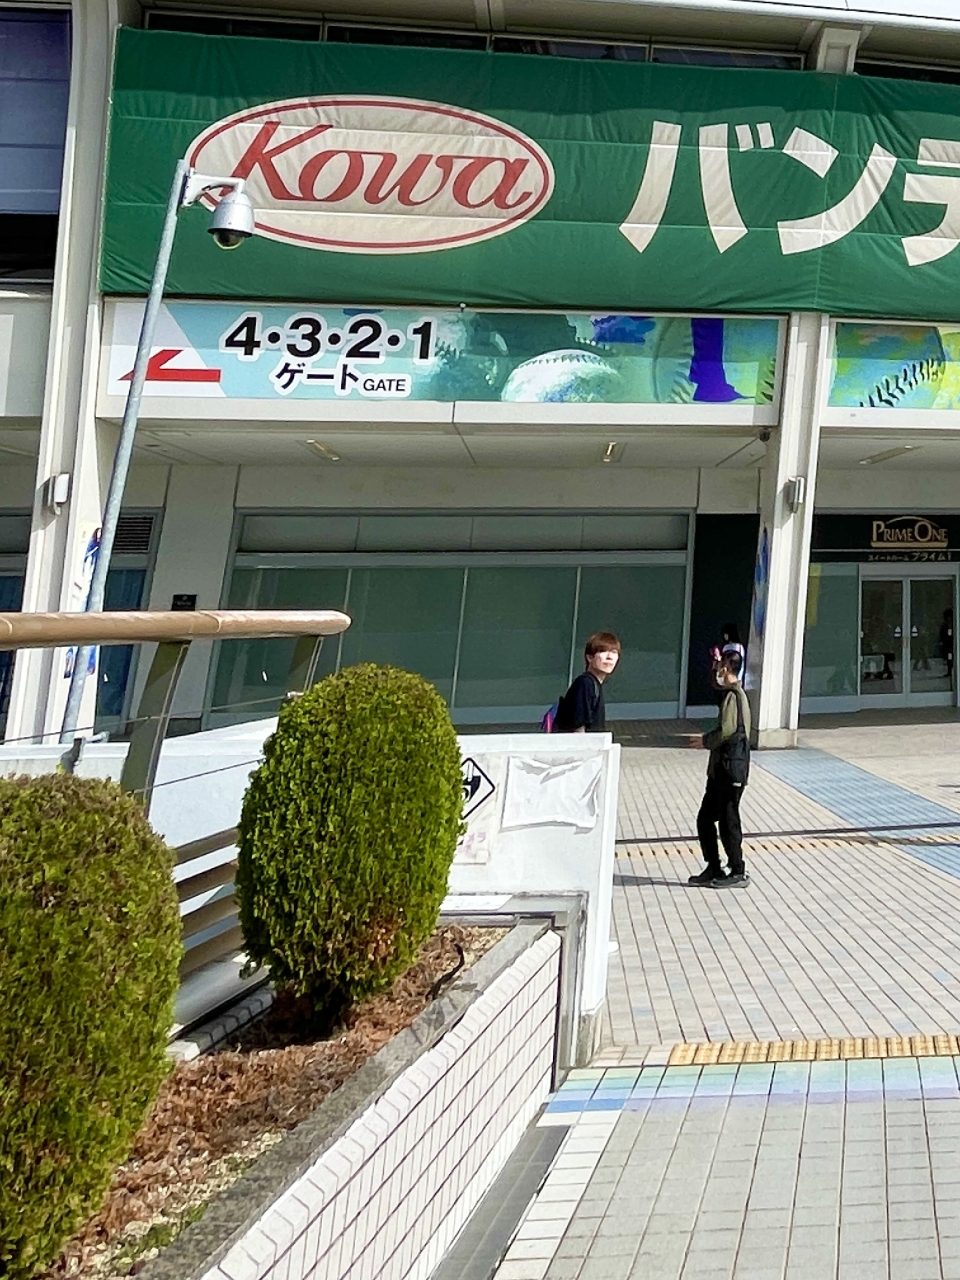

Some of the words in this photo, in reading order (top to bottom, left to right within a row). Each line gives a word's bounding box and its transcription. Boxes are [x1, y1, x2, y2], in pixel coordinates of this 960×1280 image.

[219, 120, 531, 210] Kowa
[275, 362, 359, 390] ゲート
[362, 378, 406, 392] GATE
